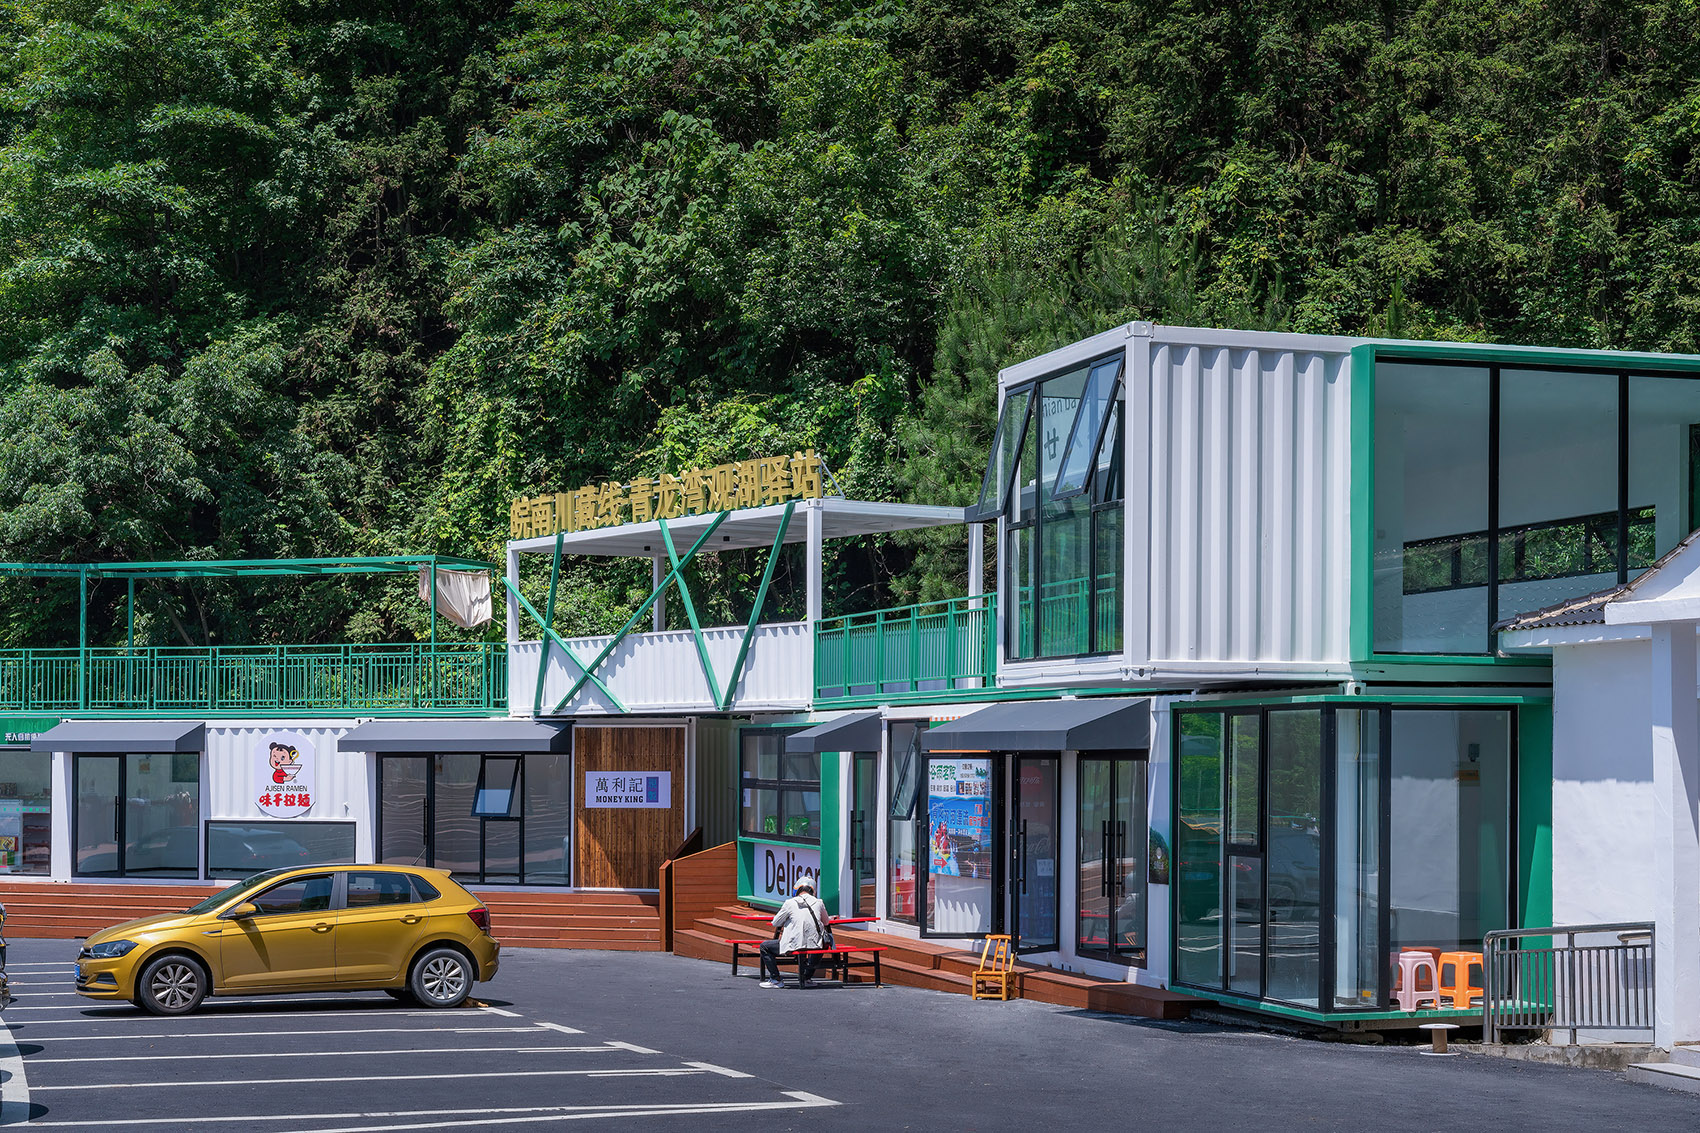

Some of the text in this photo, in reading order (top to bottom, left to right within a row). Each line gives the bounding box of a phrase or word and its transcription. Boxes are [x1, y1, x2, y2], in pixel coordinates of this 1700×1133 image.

[595, 777, 643, 793] 萬利記
[595, 795, 644, 803] MONEY KING
